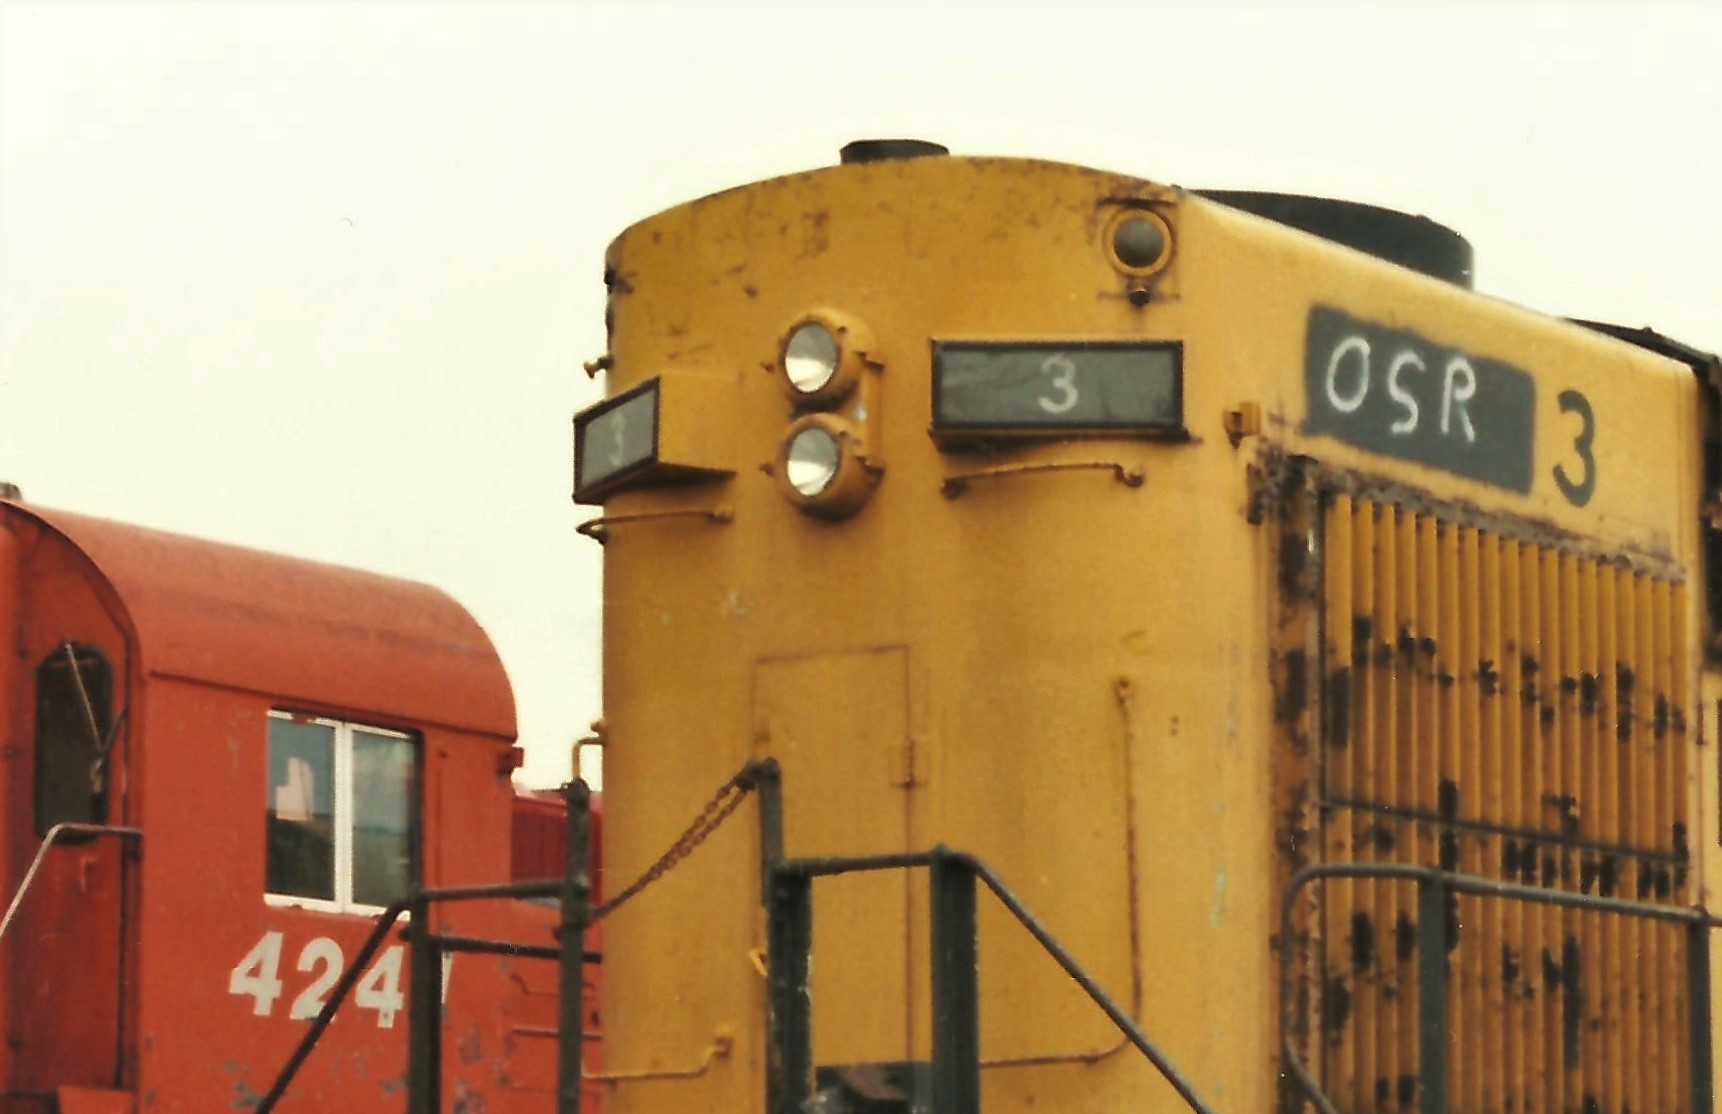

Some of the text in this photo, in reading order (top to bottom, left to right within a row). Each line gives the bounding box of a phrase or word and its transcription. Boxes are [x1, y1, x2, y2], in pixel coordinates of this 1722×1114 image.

[1039, 355, 1078, 413] 3
[1326, 336, 1596, 508] OSR 3
[229, 930, 452, 1029] 424
